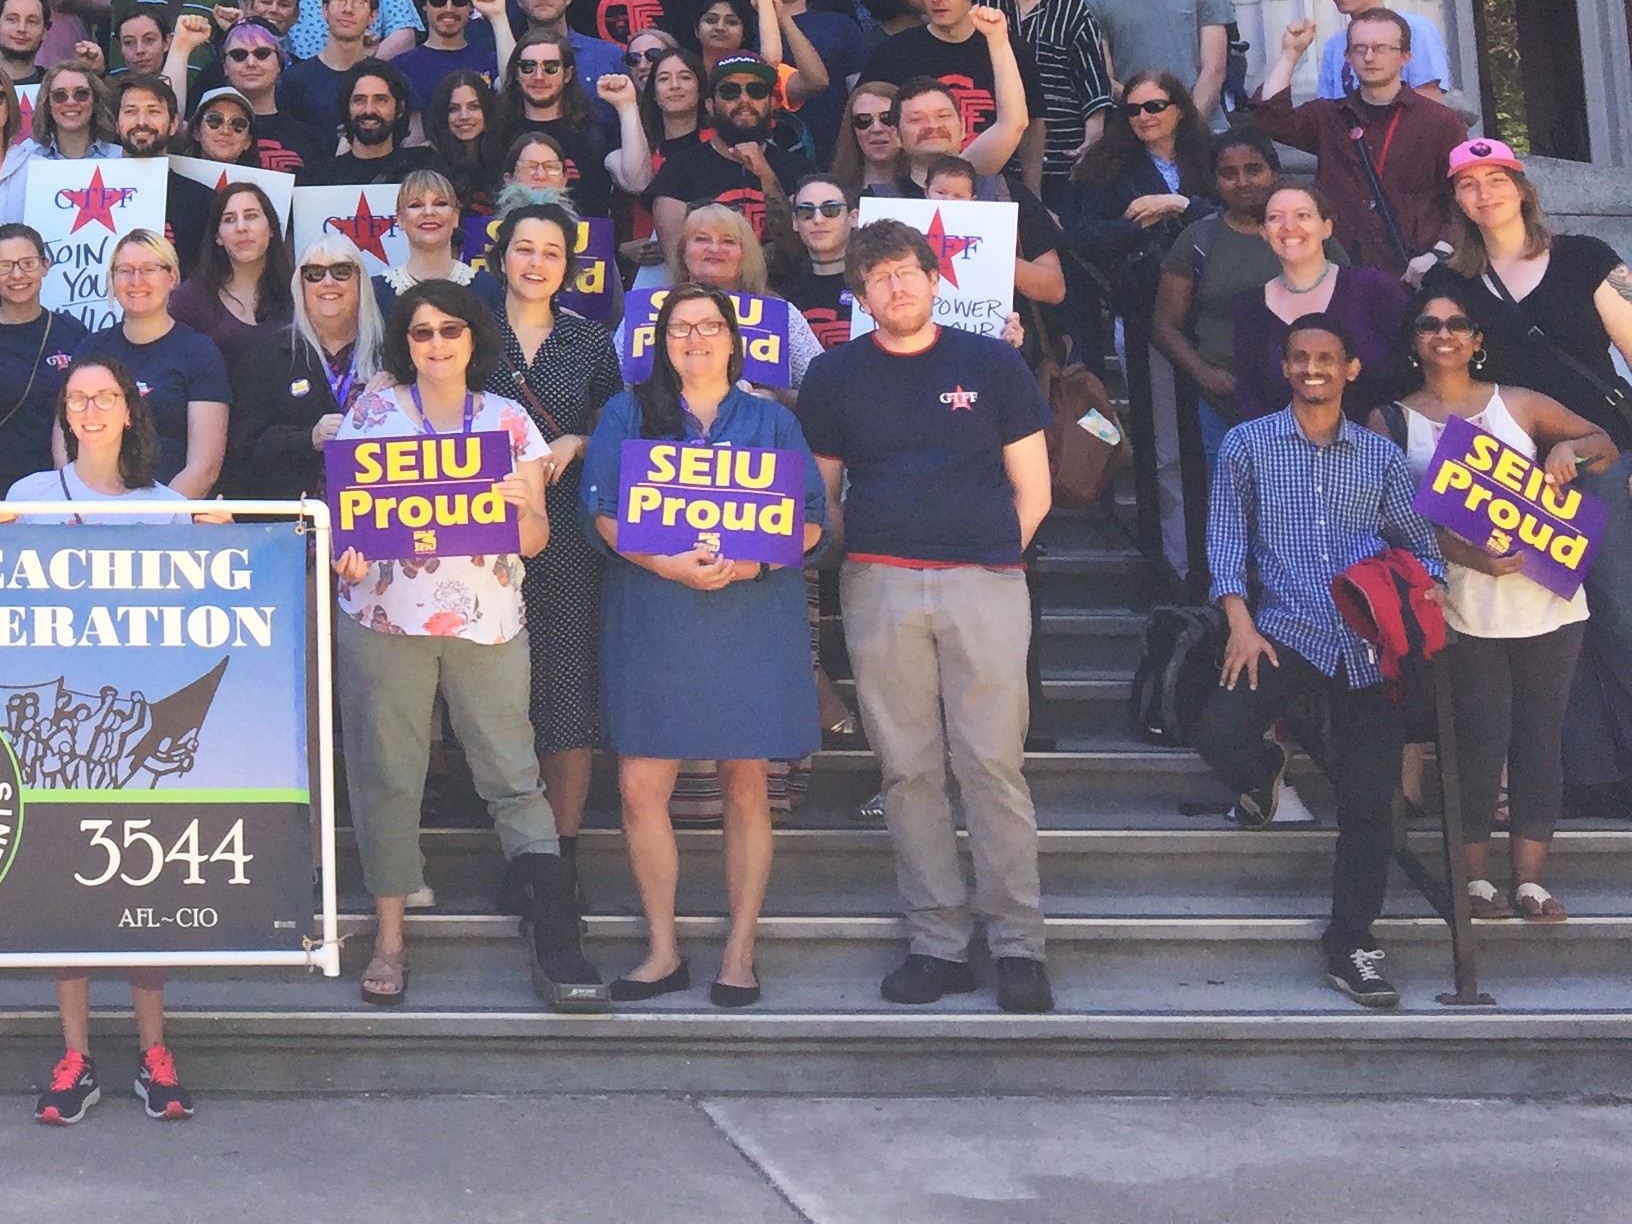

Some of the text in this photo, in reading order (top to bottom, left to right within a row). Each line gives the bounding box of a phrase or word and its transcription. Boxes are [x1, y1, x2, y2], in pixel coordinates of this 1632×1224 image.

[54, 186, 138, 211] GTFF
[43, 235, 110, 270] JOIN
[62, 266, 111, 302] YOU
[939, 391, 979, 404] GTFF
[354, 436, 482, 484] SEIU
[646, 444, 777, 490] SEIU
[1464, 434, 1583, 521] SEIU
[339, 482, 507, 531] Proud
[627, 485, 796, 537] Proud
[1431, 459, 1589, 571] Proud
[74, 818, 255, 887] 3544
